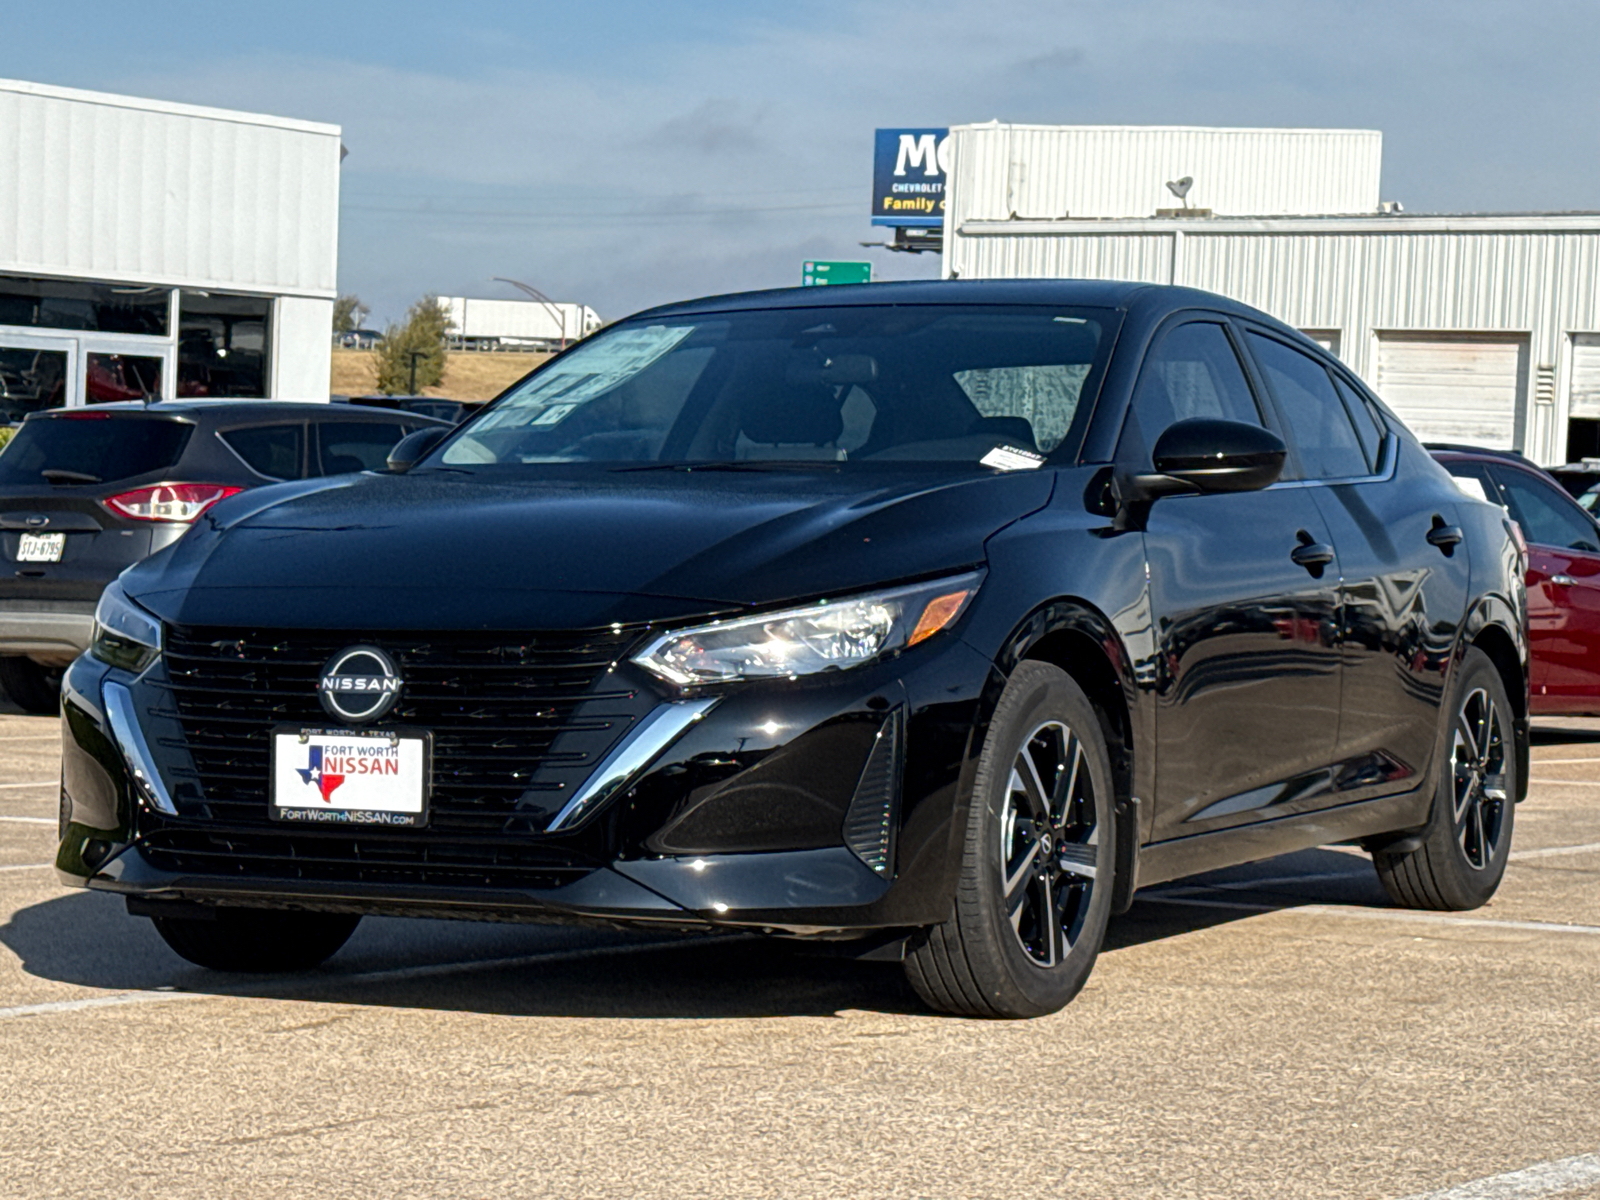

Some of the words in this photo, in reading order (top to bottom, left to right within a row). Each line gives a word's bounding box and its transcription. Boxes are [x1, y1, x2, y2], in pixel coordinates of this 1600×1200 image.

[893, 134, 948, 176] M
[892, 182, 942, 193] CHEVROLET
[883, 196, 935, 213] Family
[322, 677, 397, 691] NISSAN
[300, 728, 323, 736] FORT
[368, 730, 396, 738] TEXAS
[324, 745, 354, 756] FORT
[357, 746, 399, 757] WORTH
[324, 757, 398, 775] NISSAN
